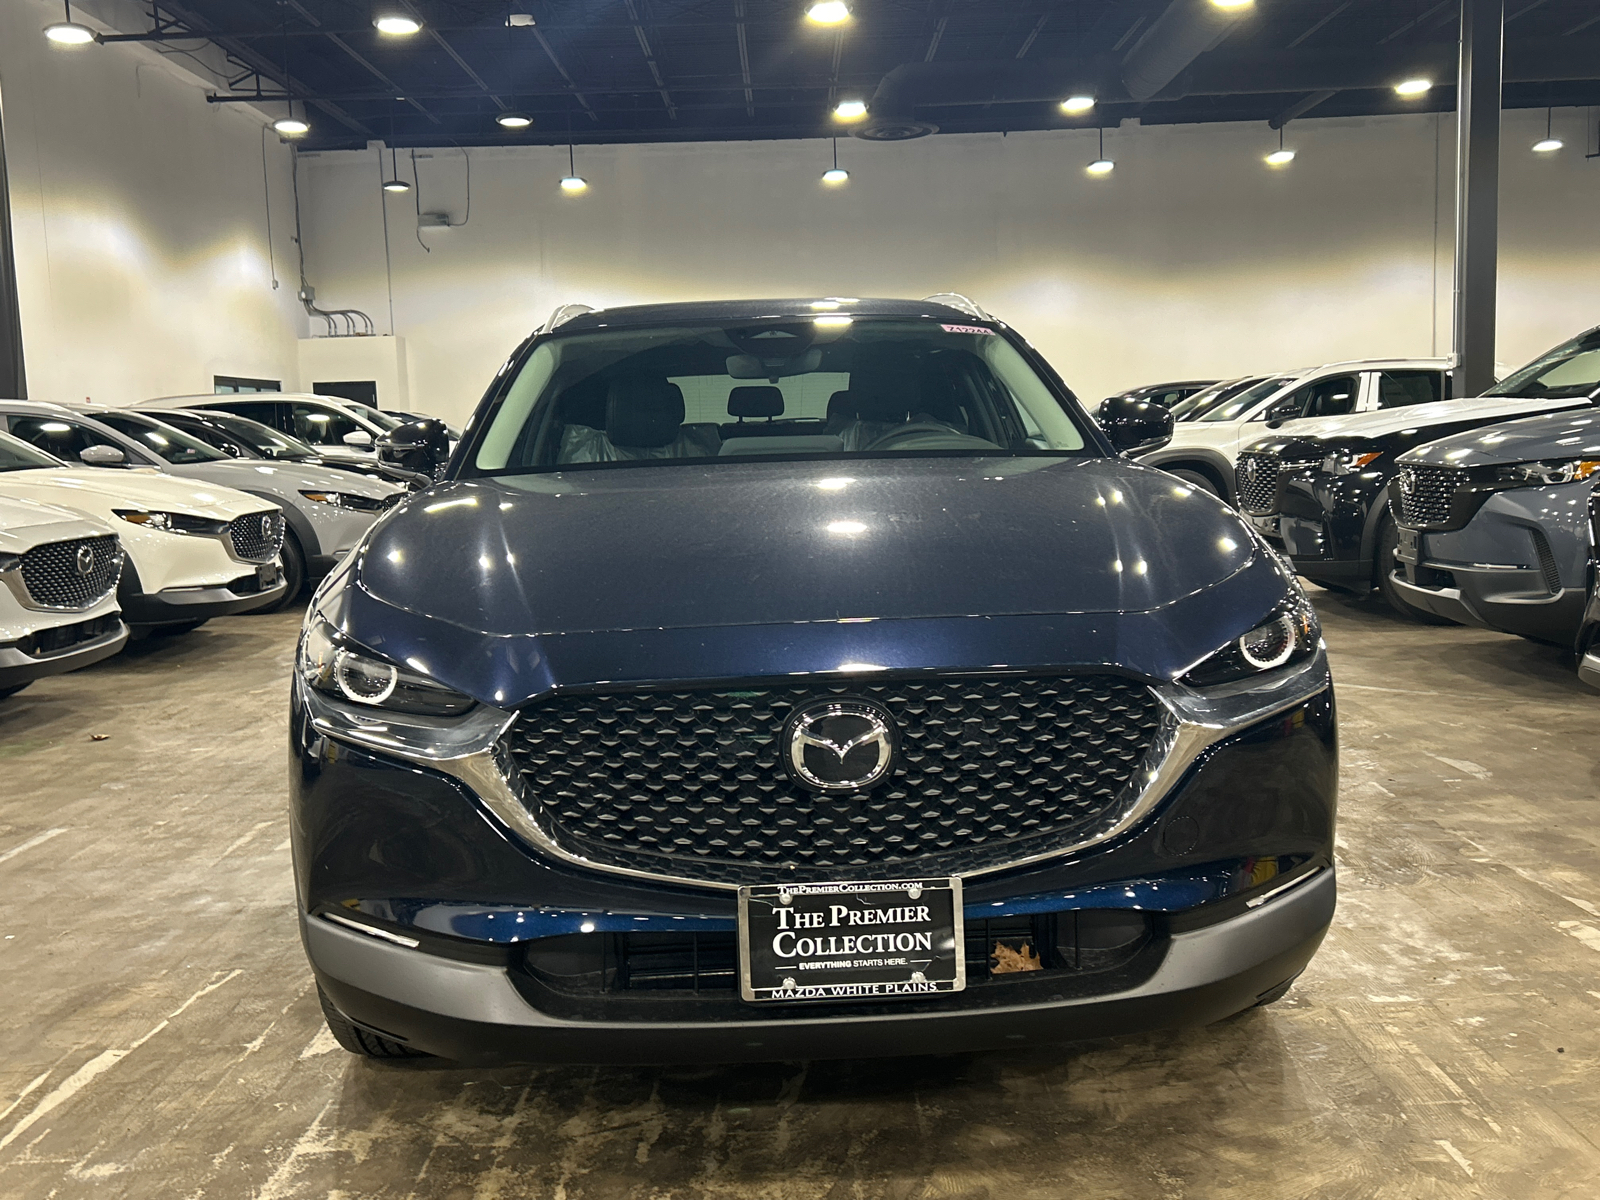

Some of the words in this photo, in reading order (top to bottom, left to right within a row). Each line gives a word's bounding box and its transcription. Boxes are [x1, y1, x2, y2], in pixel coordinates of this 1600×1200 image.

[799, 960, 851, 970] EVERYTHING
[853, 959, 883, 967] STARTS
[884, 958, 908, 966] HERE.
[771, 987, 826, 999] MAZDA
[831, 985, 879, 996] WHITE
[885, 982, 937, 993] PLAINS
